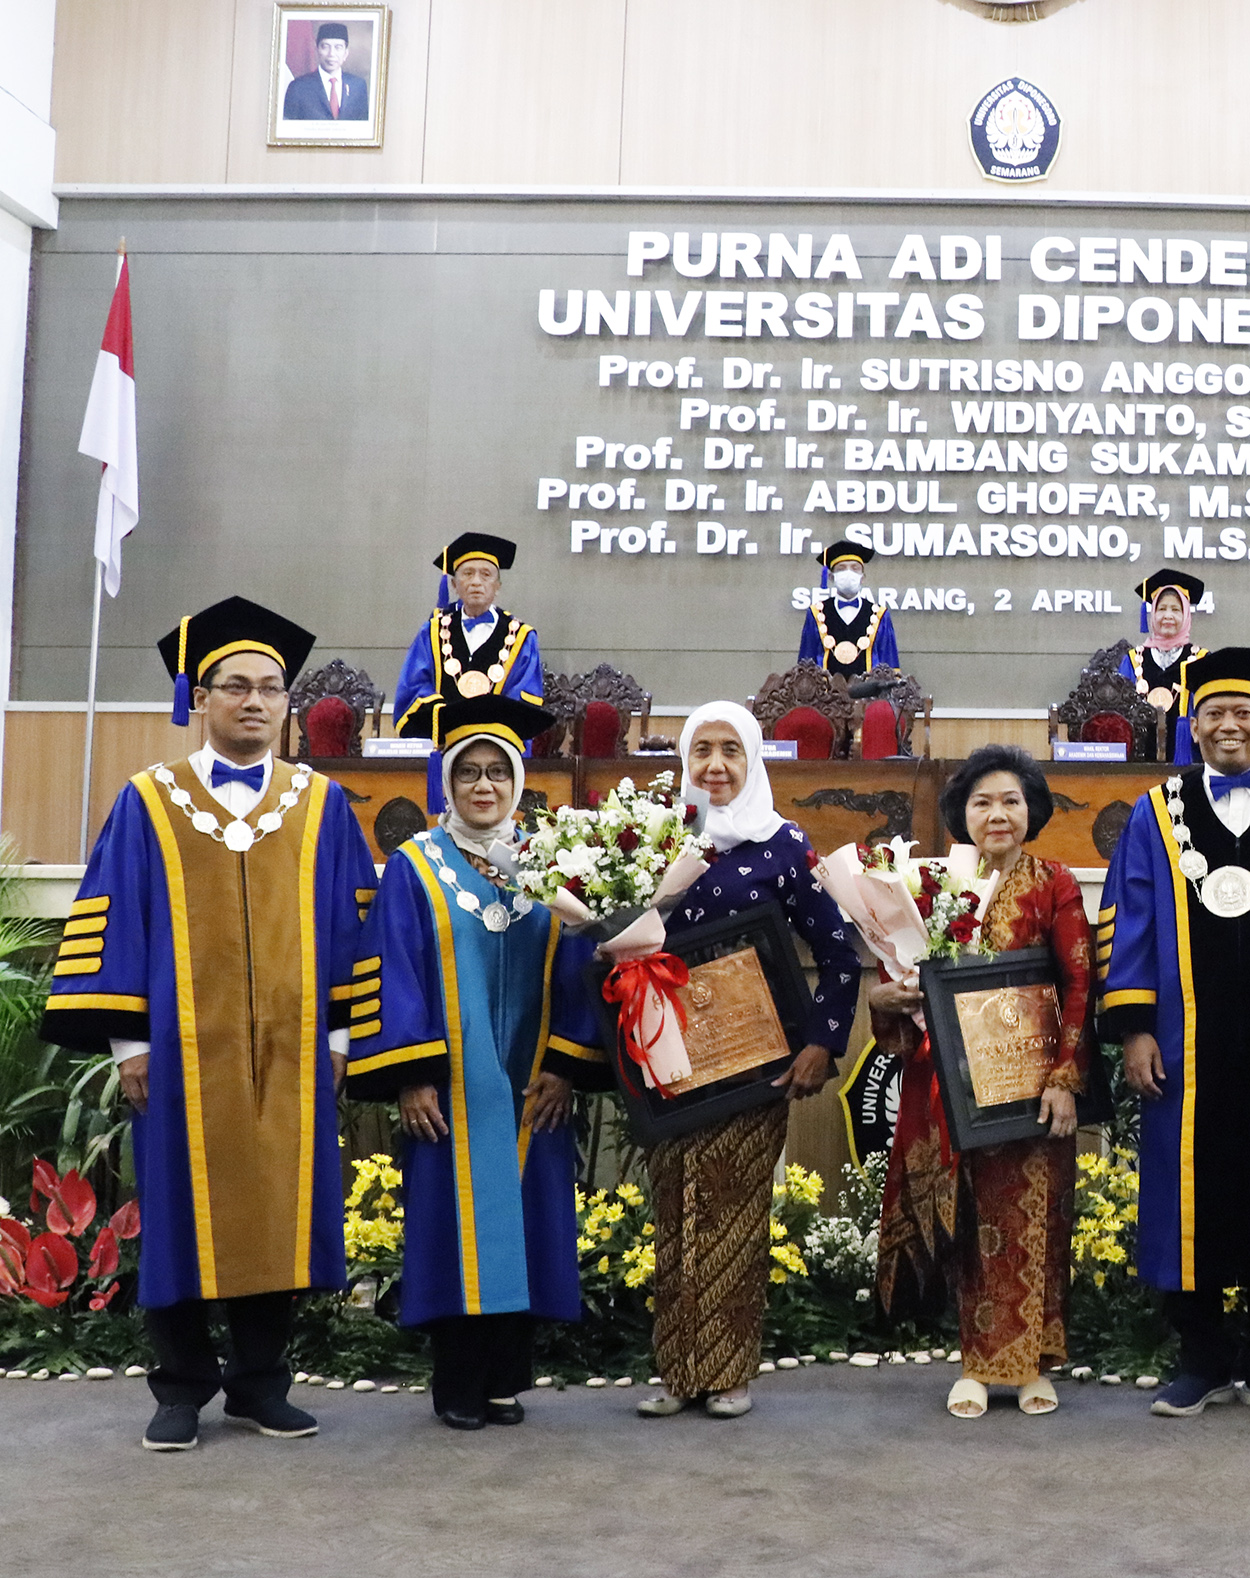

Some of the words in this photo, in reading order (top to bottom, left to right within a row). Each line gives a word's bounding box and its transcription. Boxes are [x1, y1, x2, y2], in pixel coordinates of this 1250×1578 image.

[974, 80, 1014, 126] UNIVERSITAS
[1017, 80, 1058, 126] DIPONEGORO
[990, 165, 1040, 178] SEMARANG
[626, 231, 863, 280] PURNA
[888, 234, 1002, 280] ADI
[538, 289, 985, 340] UNIVERSITAS
[599, 355, 703, 389] Prof.
[722, 358, 782, 389] Dr.
[801, 358, 841, 389] Ir.
[859, 358, 1084, 392] SUTRISNO
[680, 398, 786, 431] Prof.
[807, 400, 867, 432] Dr.
[887, 401, 928, 433] Ir.
[950, 401, 1207, 441] WIDIYANTO,
[575, 436, 683, 470] Prof.
[704, 438, 763, 469] Dr.
[785, 437, 824, 469] Ir.
[844, 439, 1068, 473] BAMBANG
[537, 478, 646, 510] Prof.
[665, 479, 725, 511] Dr.
[745, 480, 783, 512] Ir.
[803, 481, 958, 513] ABDUL
[977, 482, 1170, 523] GHOFAR,
[571, 521, 676, 553] Prof.
[697, 522, 758, 555] Dr.
[780, 522, 823, 554] Ir.
[845, 523, 1141, 562] SUMARSONO,
[791, 587, 975, 616] SERANG,
[994, 588, 1012, 611] 2
[1031, 589, 1122, 613] APRIL
[862, 1053, 895, 1124] UNIVER
